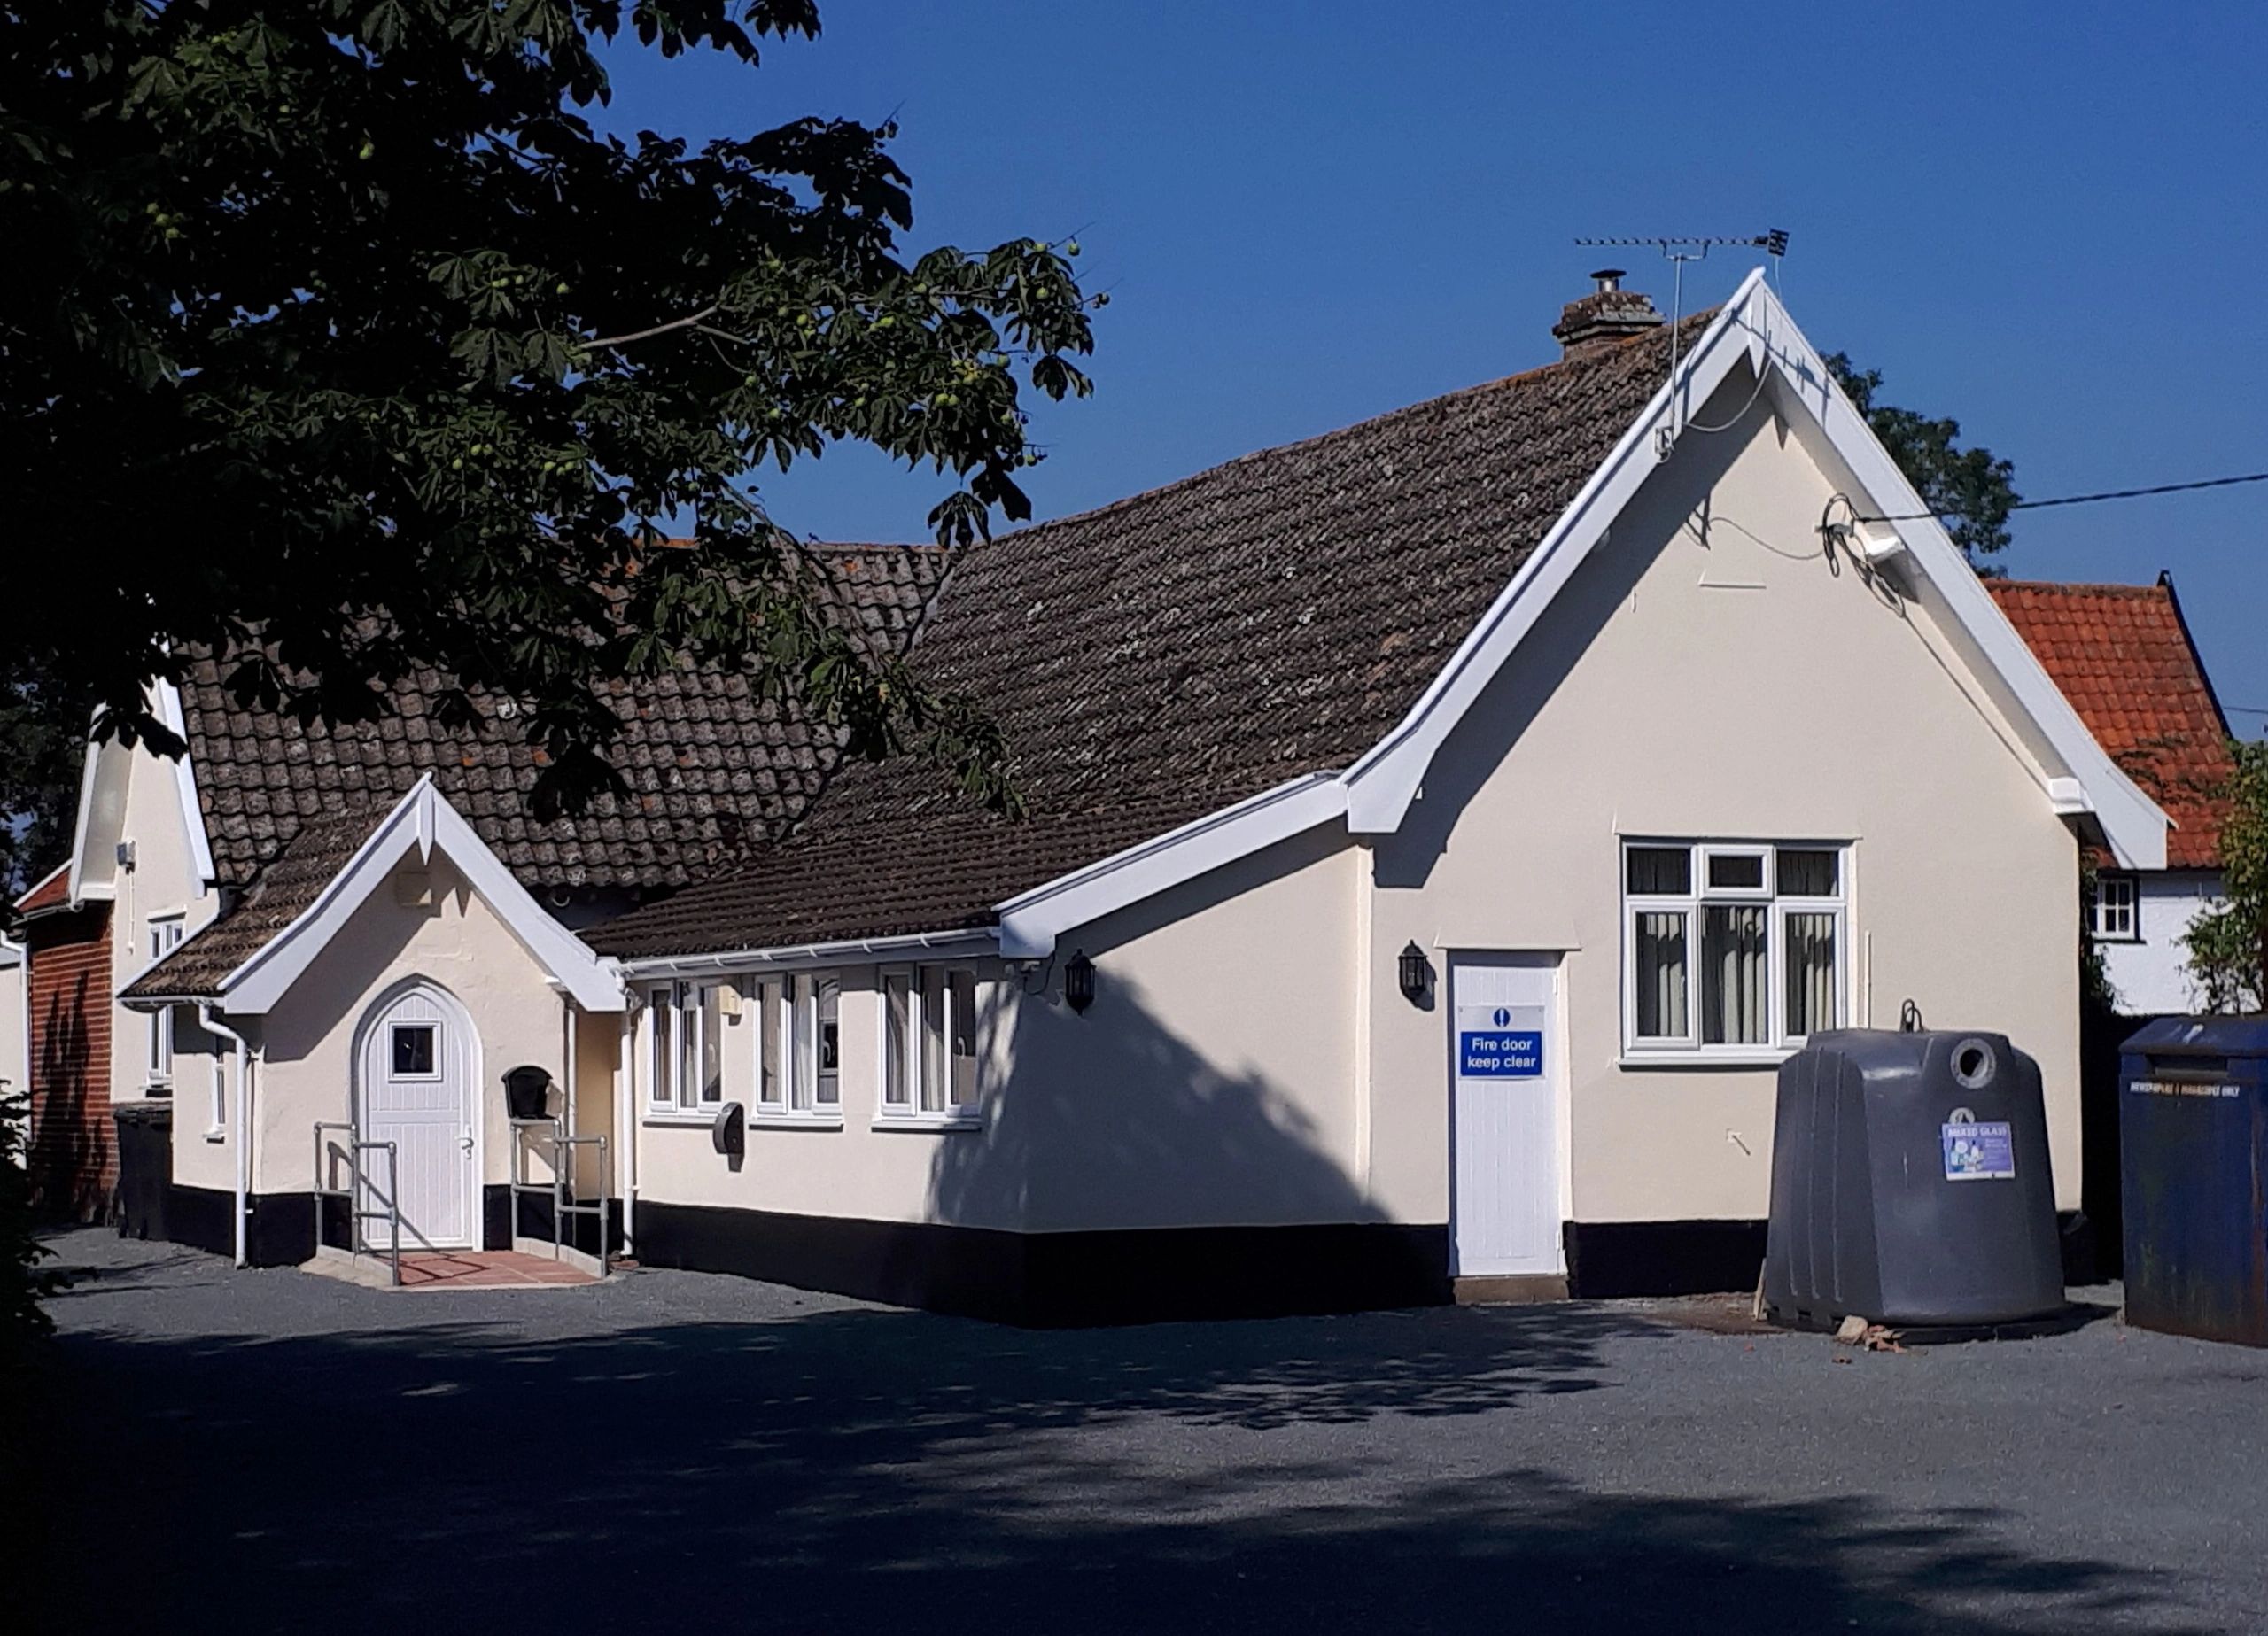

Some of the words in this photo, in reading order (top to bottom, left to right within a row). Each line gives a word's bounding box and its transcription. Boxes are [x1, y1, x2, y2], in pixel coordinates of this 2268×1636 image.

[1472, 1037, 1497, 1051] Fire
[1501, 1036, 1533, 1051] door
[1467, 1055, 1500, 1071] keep
[1503, 1054, 1536, 1067] clear
[1979, 1126, 2008, 1137] GLASS
